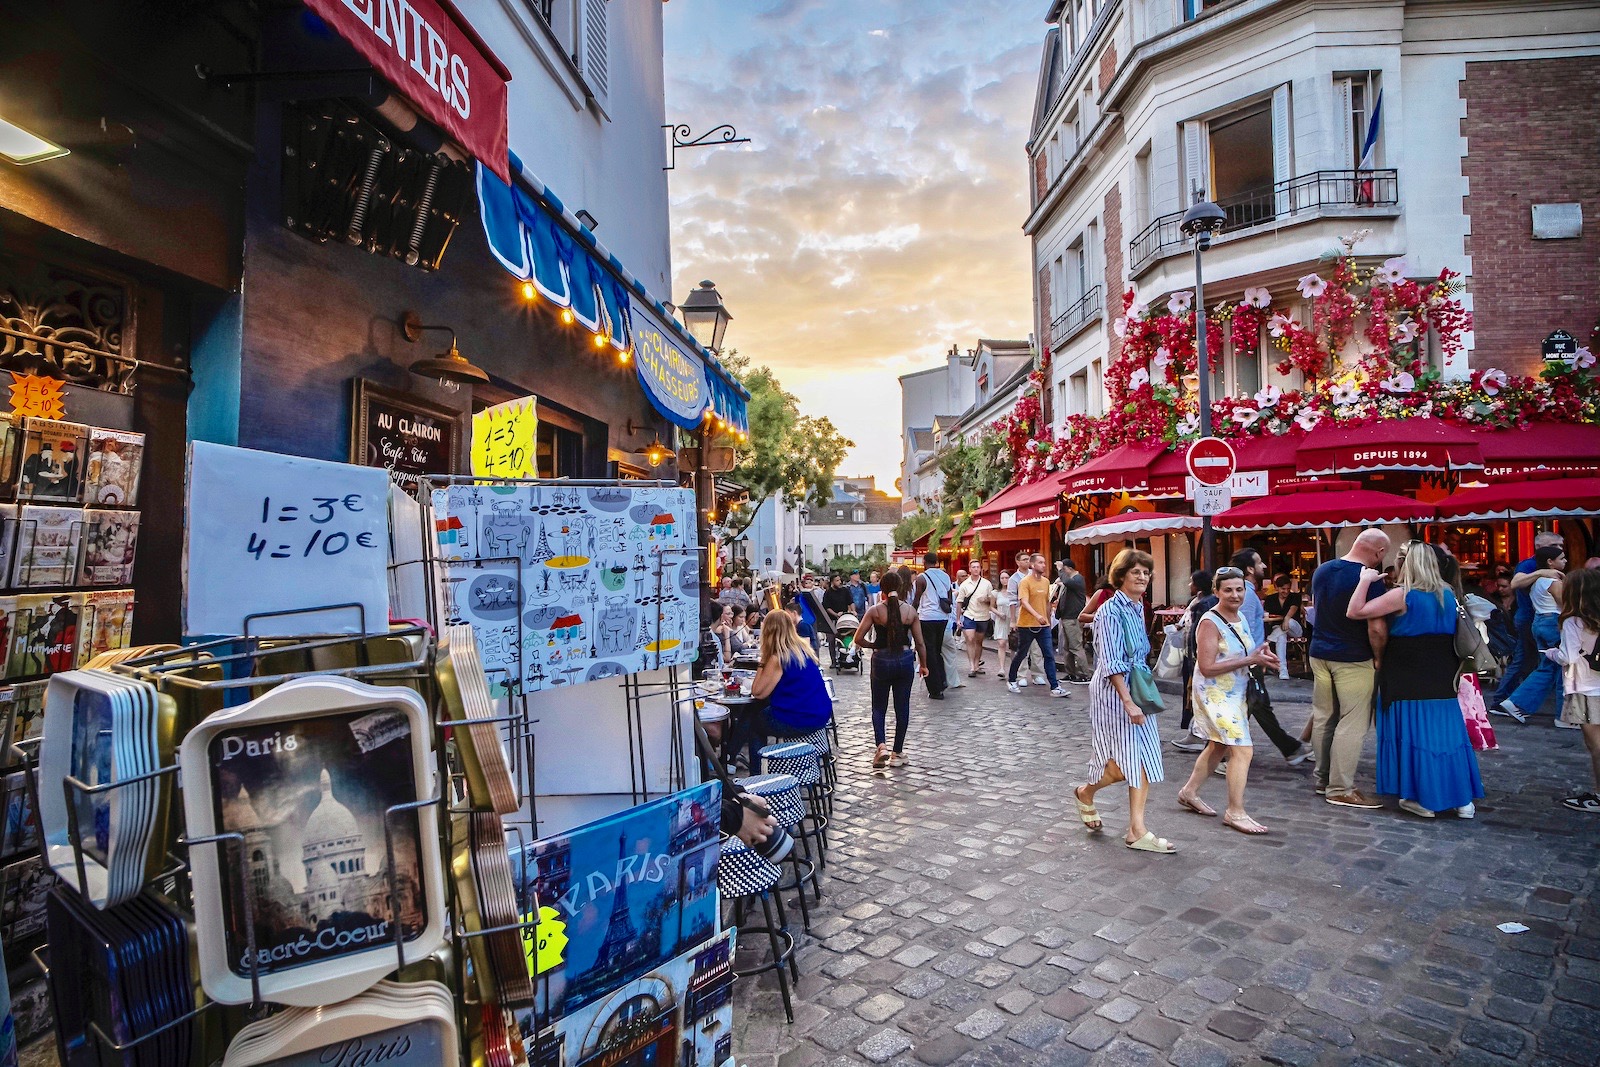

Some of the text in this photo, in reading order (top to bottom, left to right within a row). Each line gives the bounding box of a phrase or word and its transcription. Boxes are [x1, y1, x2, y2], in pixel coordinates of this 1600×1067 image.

[652, 332, 688, 377] CLAIRON
[642, 341, 698, 402] CHASSEURS
[32, 420, 86, 433] ABSINTHE
[377, 412, 441, 442] AU CLAIRON
[411, 446, 429, 464] Thé
[1353, 450, 1428, 461] DEPUIS 1894
[1072, 477, 1105, 488] LICENCE IV
[1203, 489, 1223, 497] SAUF
[485, 628, 501, 665] PARIS
[221, 731, 298, 761] Paris
[557, 852, 672, 917] PARIS
[319, 1035, 413, 1067] Paris
